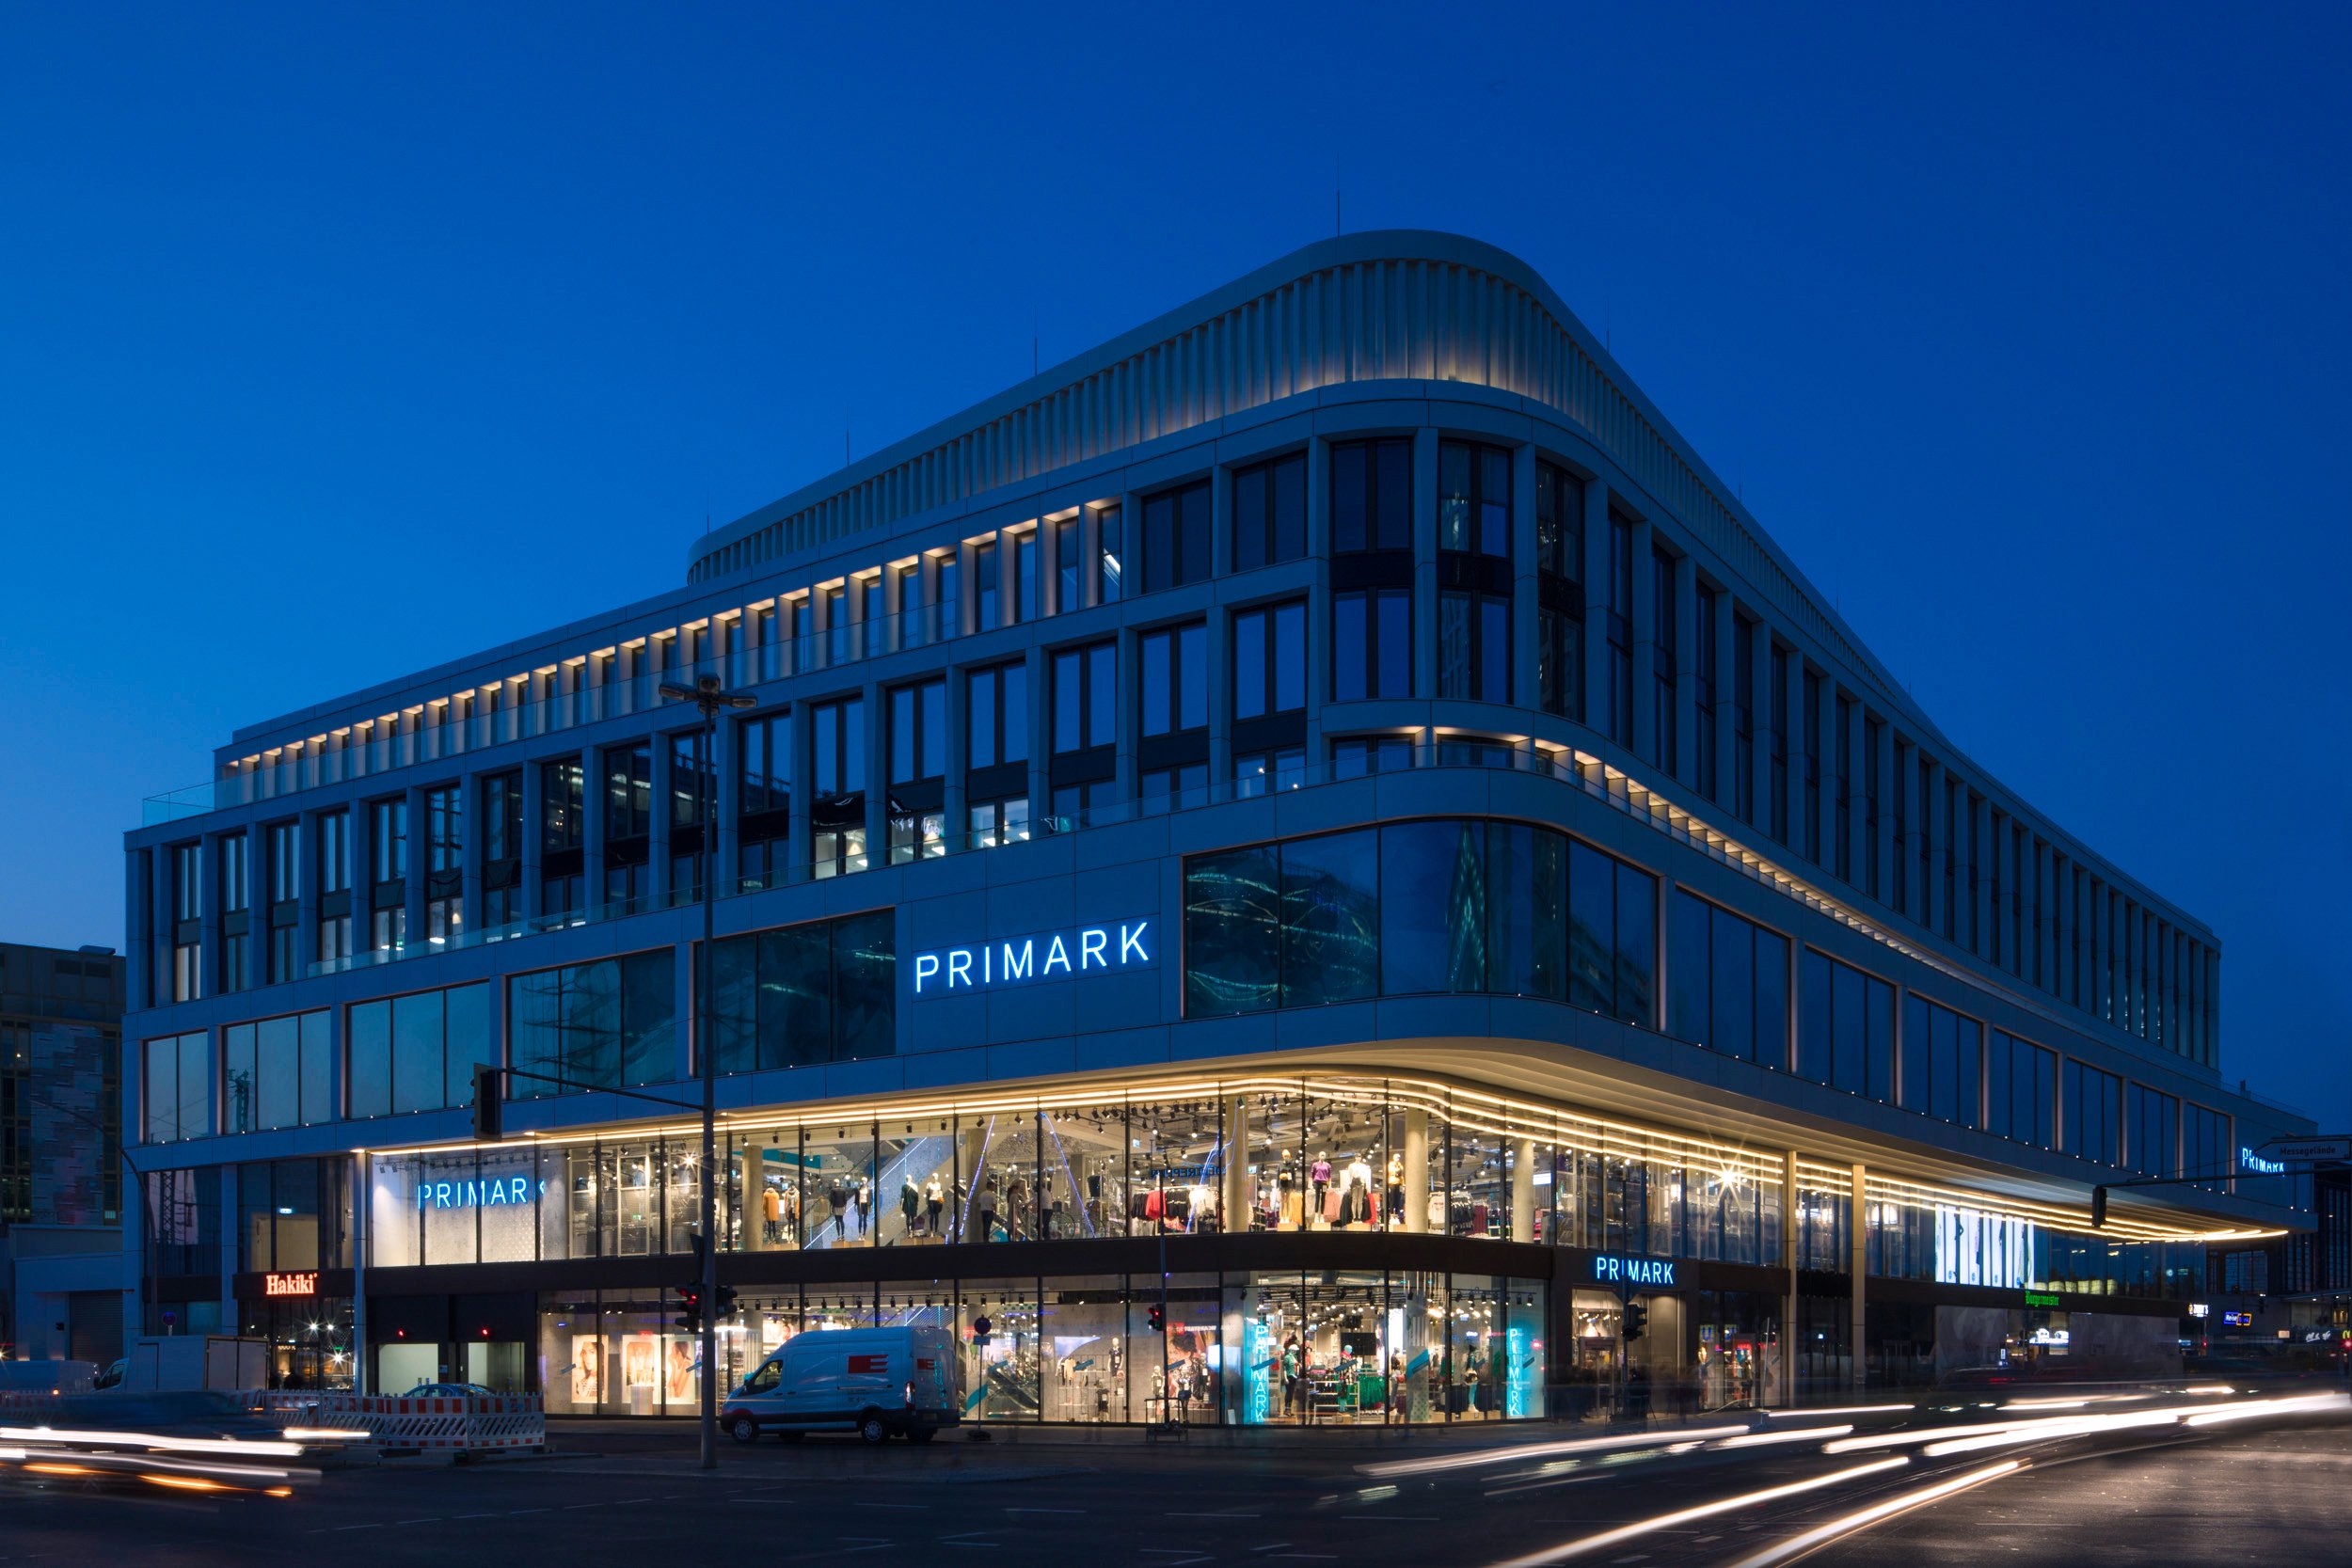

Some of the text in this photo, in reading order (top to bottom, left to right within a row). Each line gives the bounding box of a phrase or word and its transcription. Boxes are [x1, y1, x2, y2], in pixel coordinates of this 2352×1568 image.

[916, 922, 1149, 993] PRIMARK
[2280, 1145, 2336, 1156] Messegelände
[1597, 1257, 1674, 1284] PRIMARK
[265, 1273, 315, 1295] Hakiki
